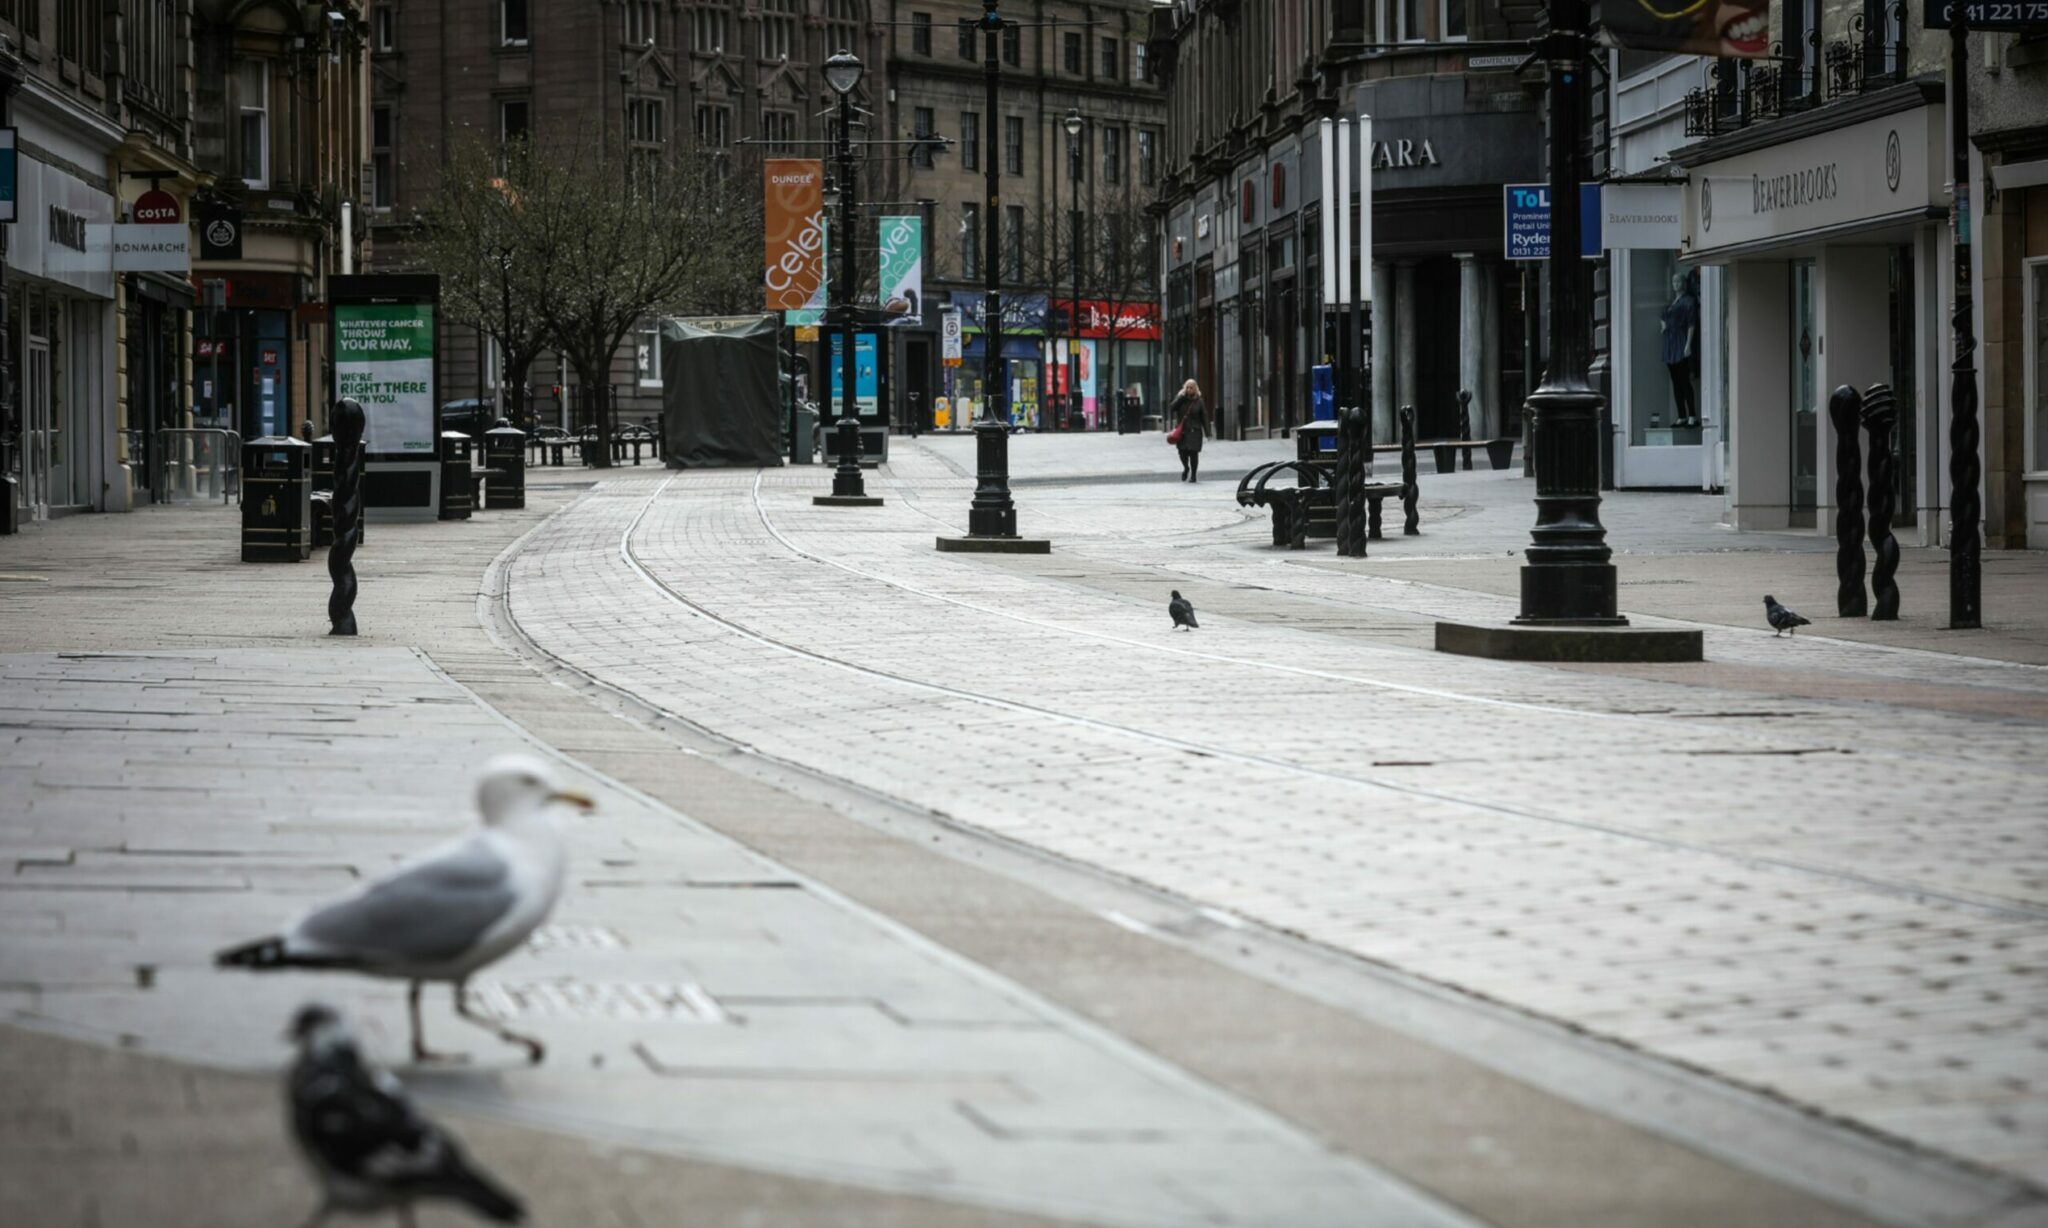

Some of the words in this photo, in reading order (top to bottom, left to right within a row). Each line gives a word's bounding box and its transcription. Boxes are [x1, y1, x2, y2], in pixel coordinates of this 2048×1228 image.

[1943, 4, 1984, 22] 041
[1989, 4, 2022, 20] 221
[772, 175, 811, 184] DUNDEE
[1753, 163, 1838, 214] BEAVERBROOKS
[1513, 189, 1551, 208] ToL
[137, 207, 176, 219] COSTA
[1609, 213, 1679, 223] BEAVERBROOKS
[1513, 222, 1535, 230] Retail
[114, 243, 186, 253] BONMARCHE
[1513, 247, 1531, 256] 0131
[1533, 247, 1551, 256] 225
[339, 320, 388, 328] WHATEVER
[389, 319, 424, 328] CANCER
[342, 329, 387, 338] THROWS
[340, 339, 378, 350] YOUR
[340, 373, 373, 381] WE'RE
[340, 383, 381, 394] RIGHT
[383, 382, 427, 393] THERE
